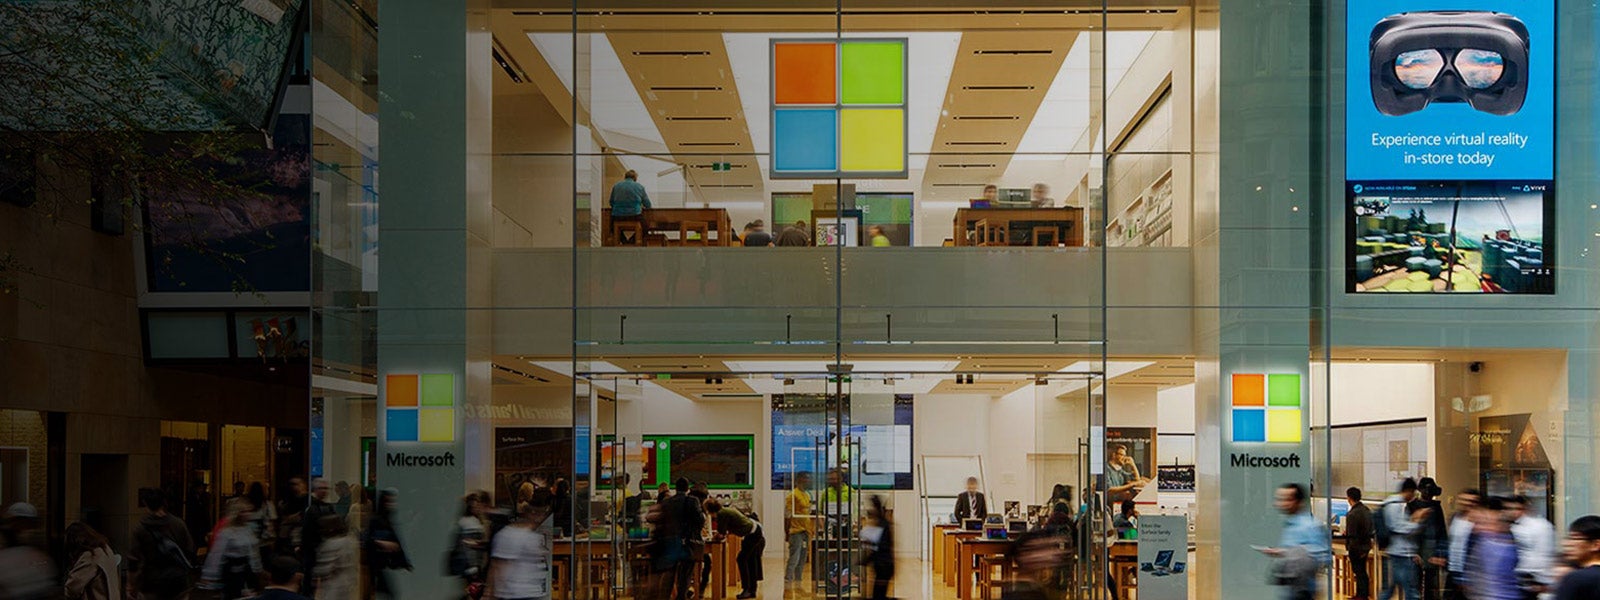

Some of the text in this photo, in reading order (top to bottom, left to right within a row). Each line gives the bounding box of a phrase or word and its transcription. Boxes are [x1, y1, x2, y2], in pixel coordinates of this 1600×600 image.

[1371, 132, 1528, 149] Experience virtual reality
[1404, 151, 1495, 167] in-store today
[386, 451, 455, 467] Microsoft
[1230, 452, 1301, 468] Microsoft
